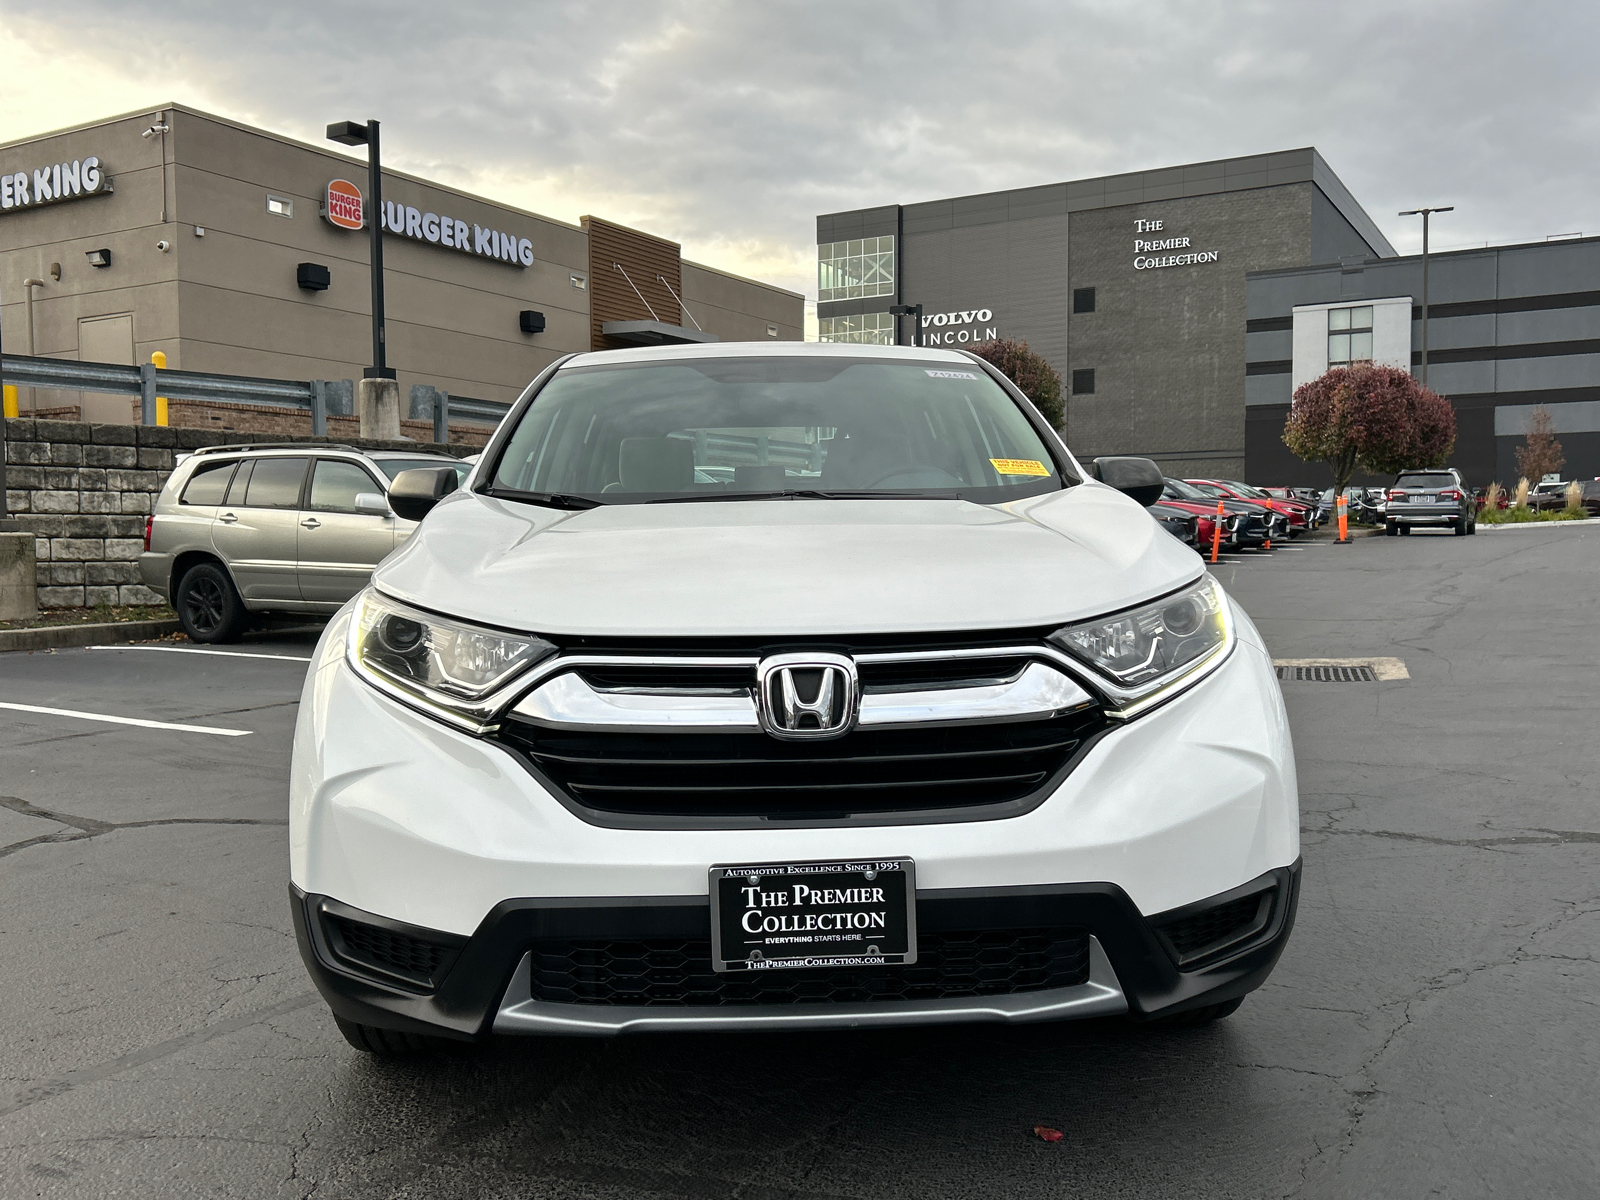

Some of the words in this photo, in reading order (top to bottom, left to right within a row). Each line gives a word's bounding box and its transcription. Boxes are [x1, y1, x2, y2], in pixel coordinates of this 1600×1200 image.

[33, 156, 100, 202] KING
[329, 191, 361, 208] BURGER
[329, 201, 362, 221] KING
[474, 223, 534, 267] KING
[914, 308, 993, 328] VOLVO
[910, 327, 997, 346] LINCOLN
[875, 862, 900, 871] 1995
[765, 936, 813, 944] EVERYTHING
[814, 935, 841, 943] STARTS
